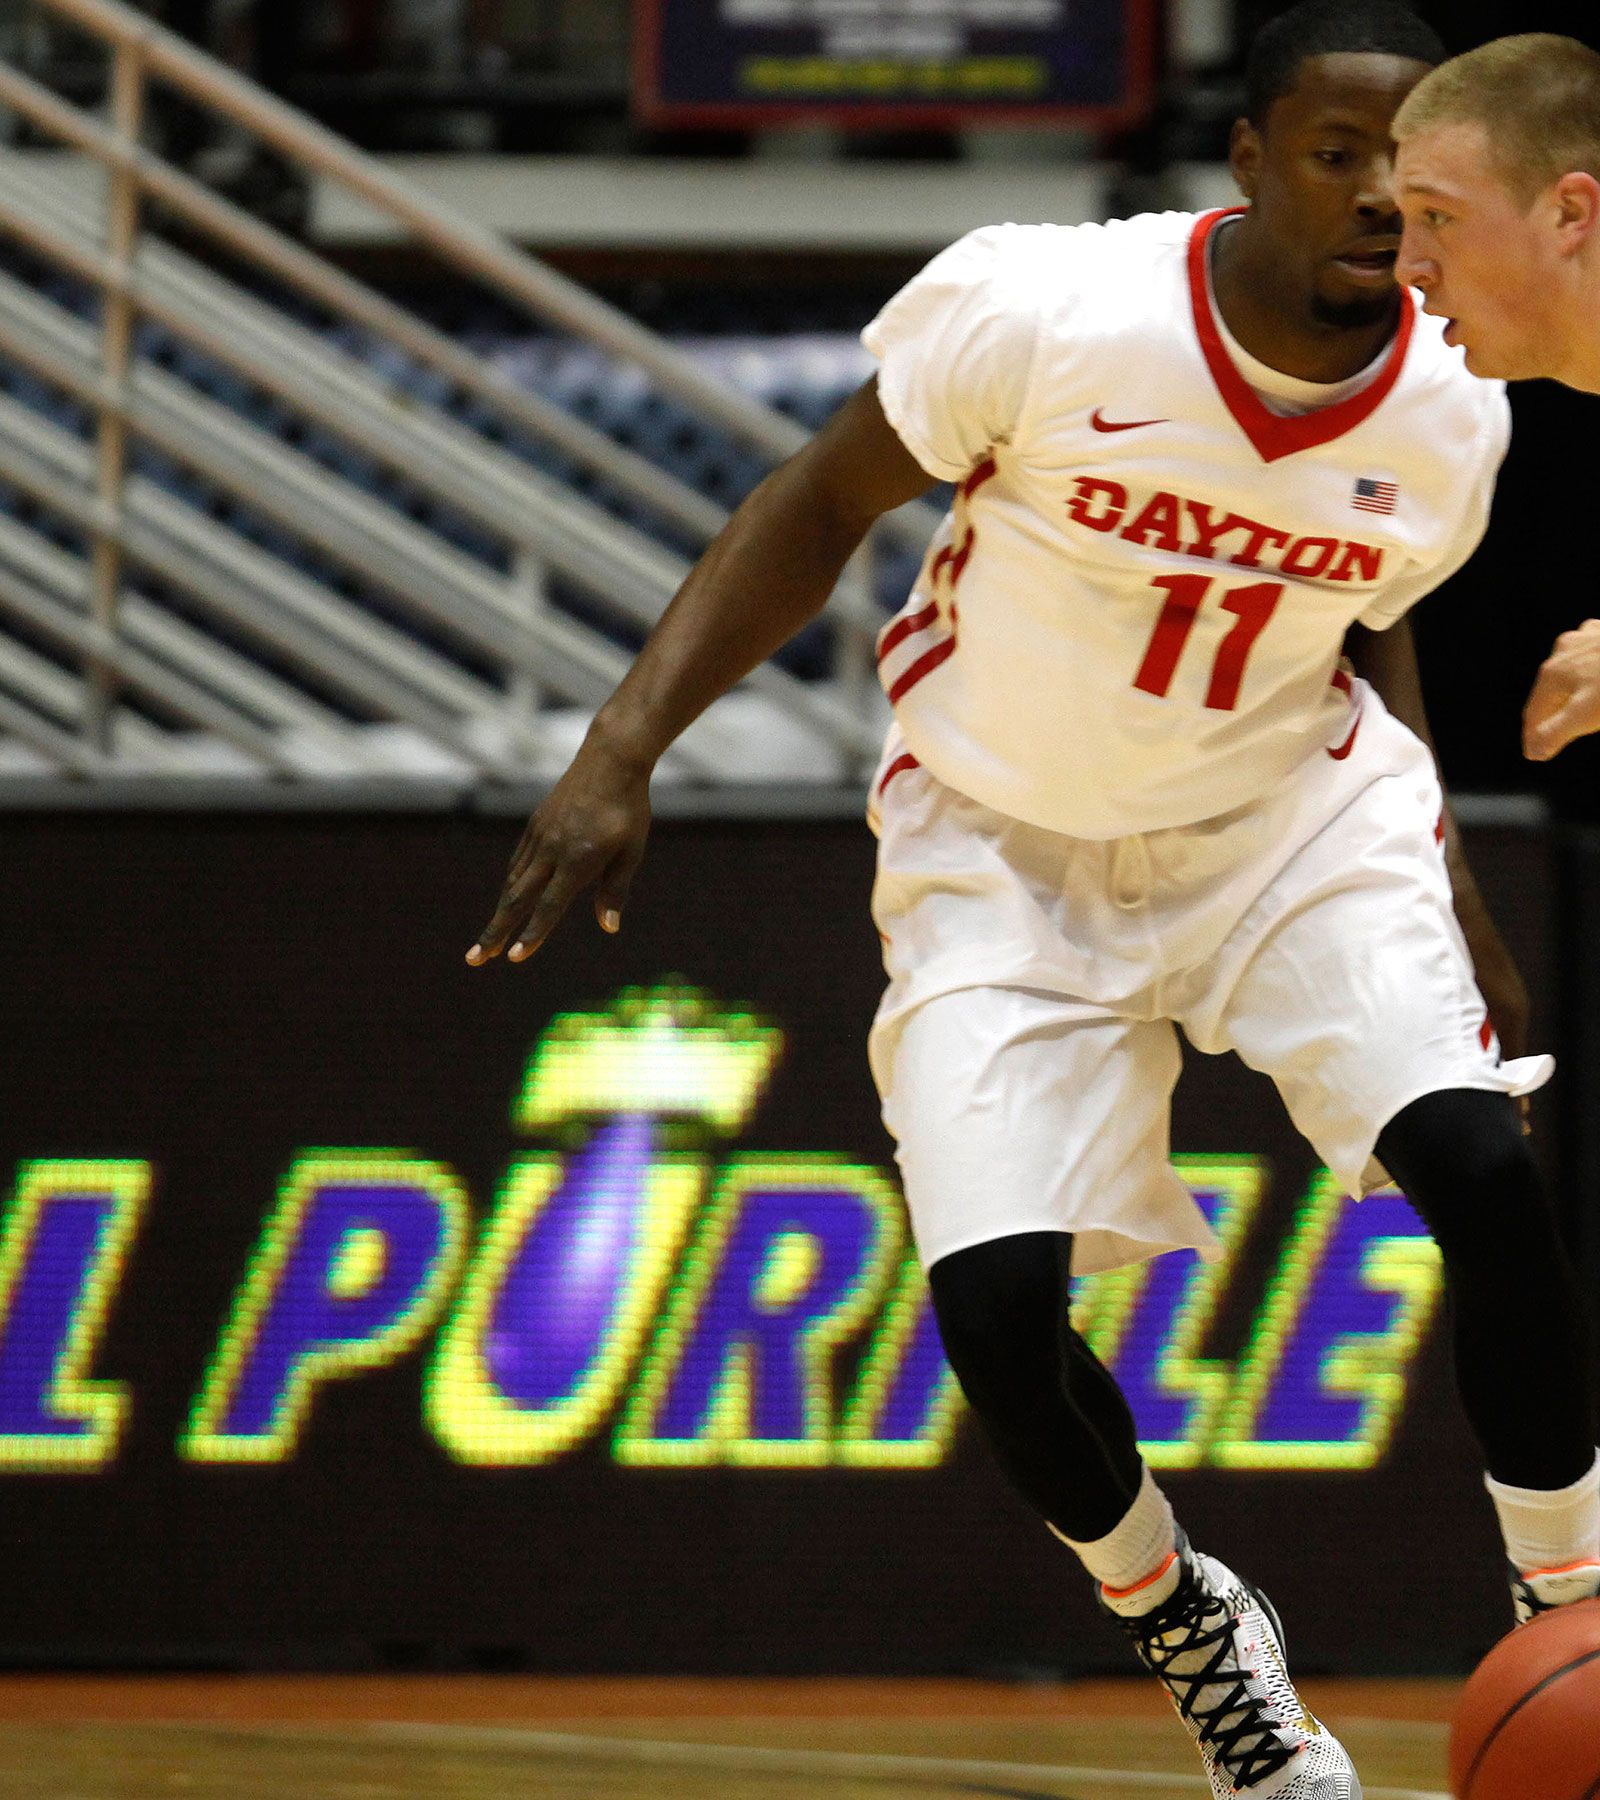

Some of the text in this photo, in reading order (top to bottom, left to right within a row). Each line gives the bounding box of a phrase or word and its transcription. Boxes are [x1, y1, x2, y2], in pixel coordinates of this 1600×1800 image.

[1065, 475, 1388, 583] DAYTON
[1132, 573, 1285, 712] 11
[176, 1147, 1446, 1470] PURLE
